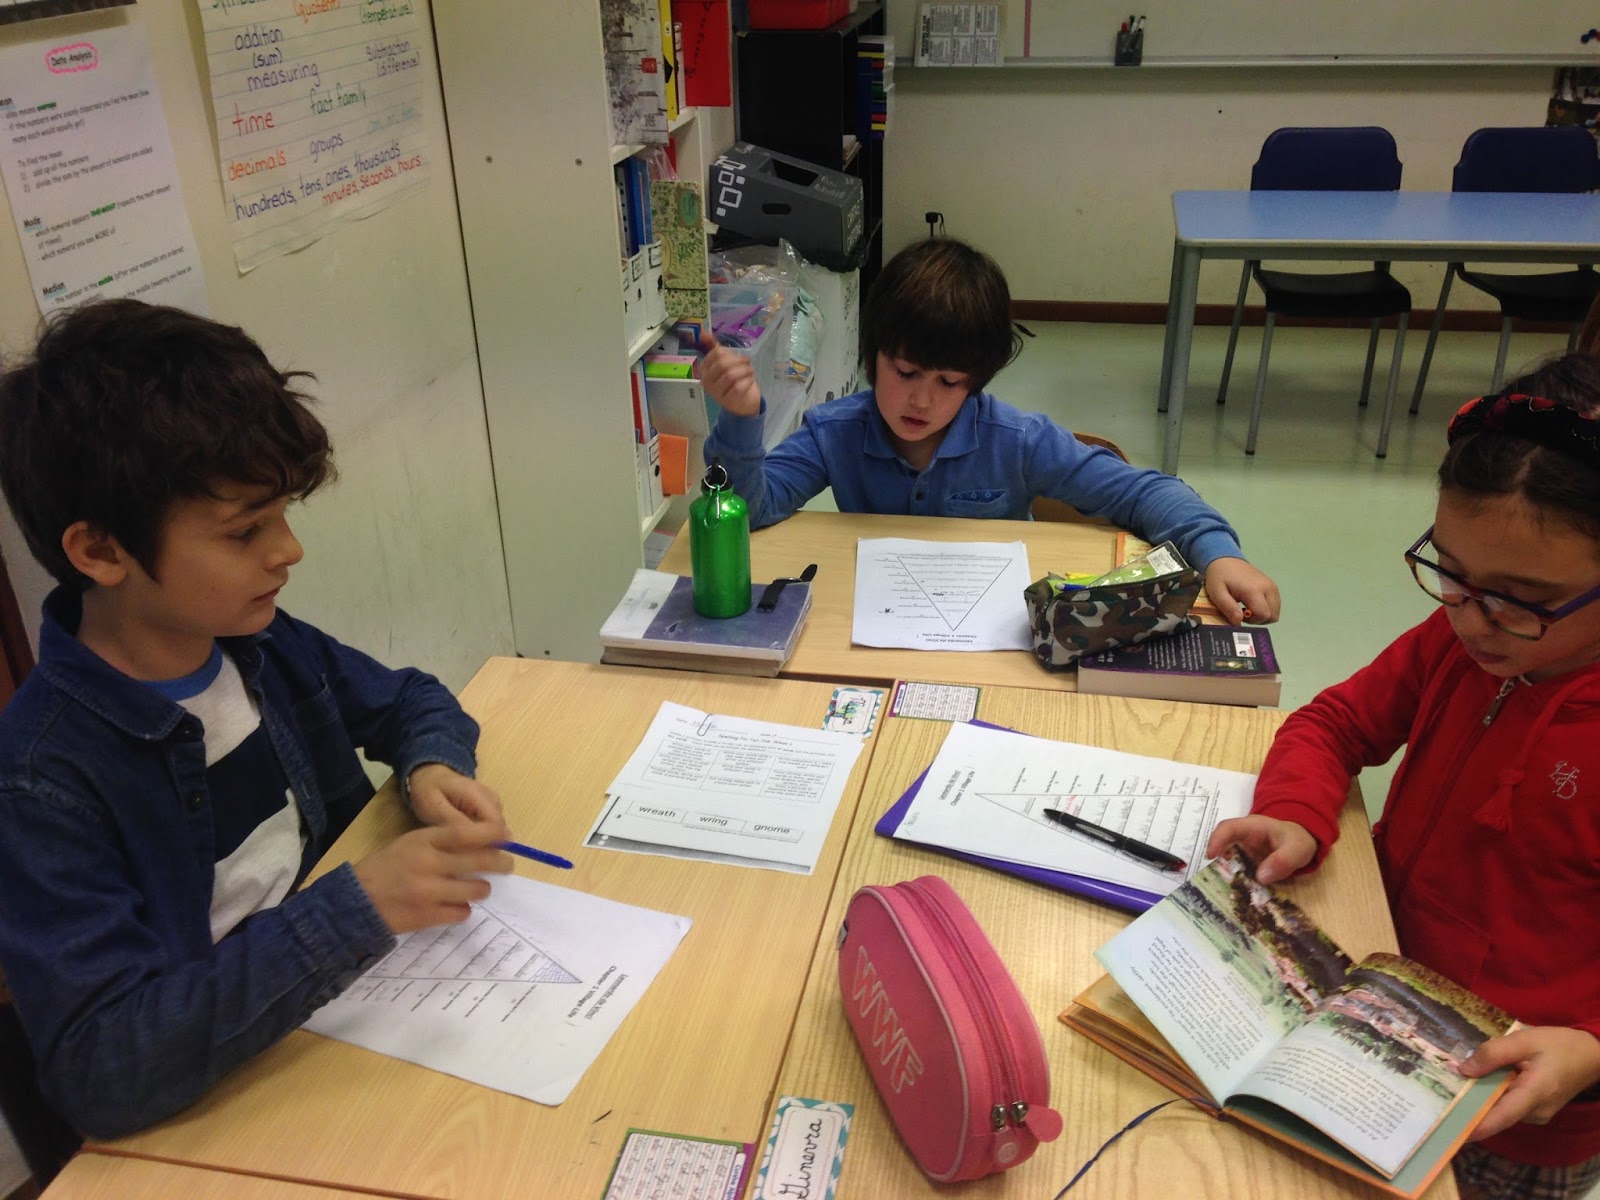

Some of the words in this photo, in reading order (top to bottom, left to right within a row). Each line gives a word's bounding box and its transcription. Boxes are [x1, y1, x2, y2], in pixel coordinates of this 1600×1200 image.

[235, 27, 284, 51] addition
[51, 54, 67, 66] Data
[69, 51, 93, 64] Analysis
[253, 49, 282, 68] (sum)
[247, 63, 320, 92] measuring
[310, 84, 333, 116] fact
[337, 82, 366, 109] family
[232, 103, 275, 136] time
[309, 132, 344, 163] groups
[354, 141, 400, 173] thousands
[228, 150, 287, 181] decimals
[398, 153, 421, 174] hours
[639, 806, 676, 818] wreath
[700, 815, 728, 827] wring
[754, 823, 790, 835] gnome
[778, 1118, 822, 1200] Ginevra
